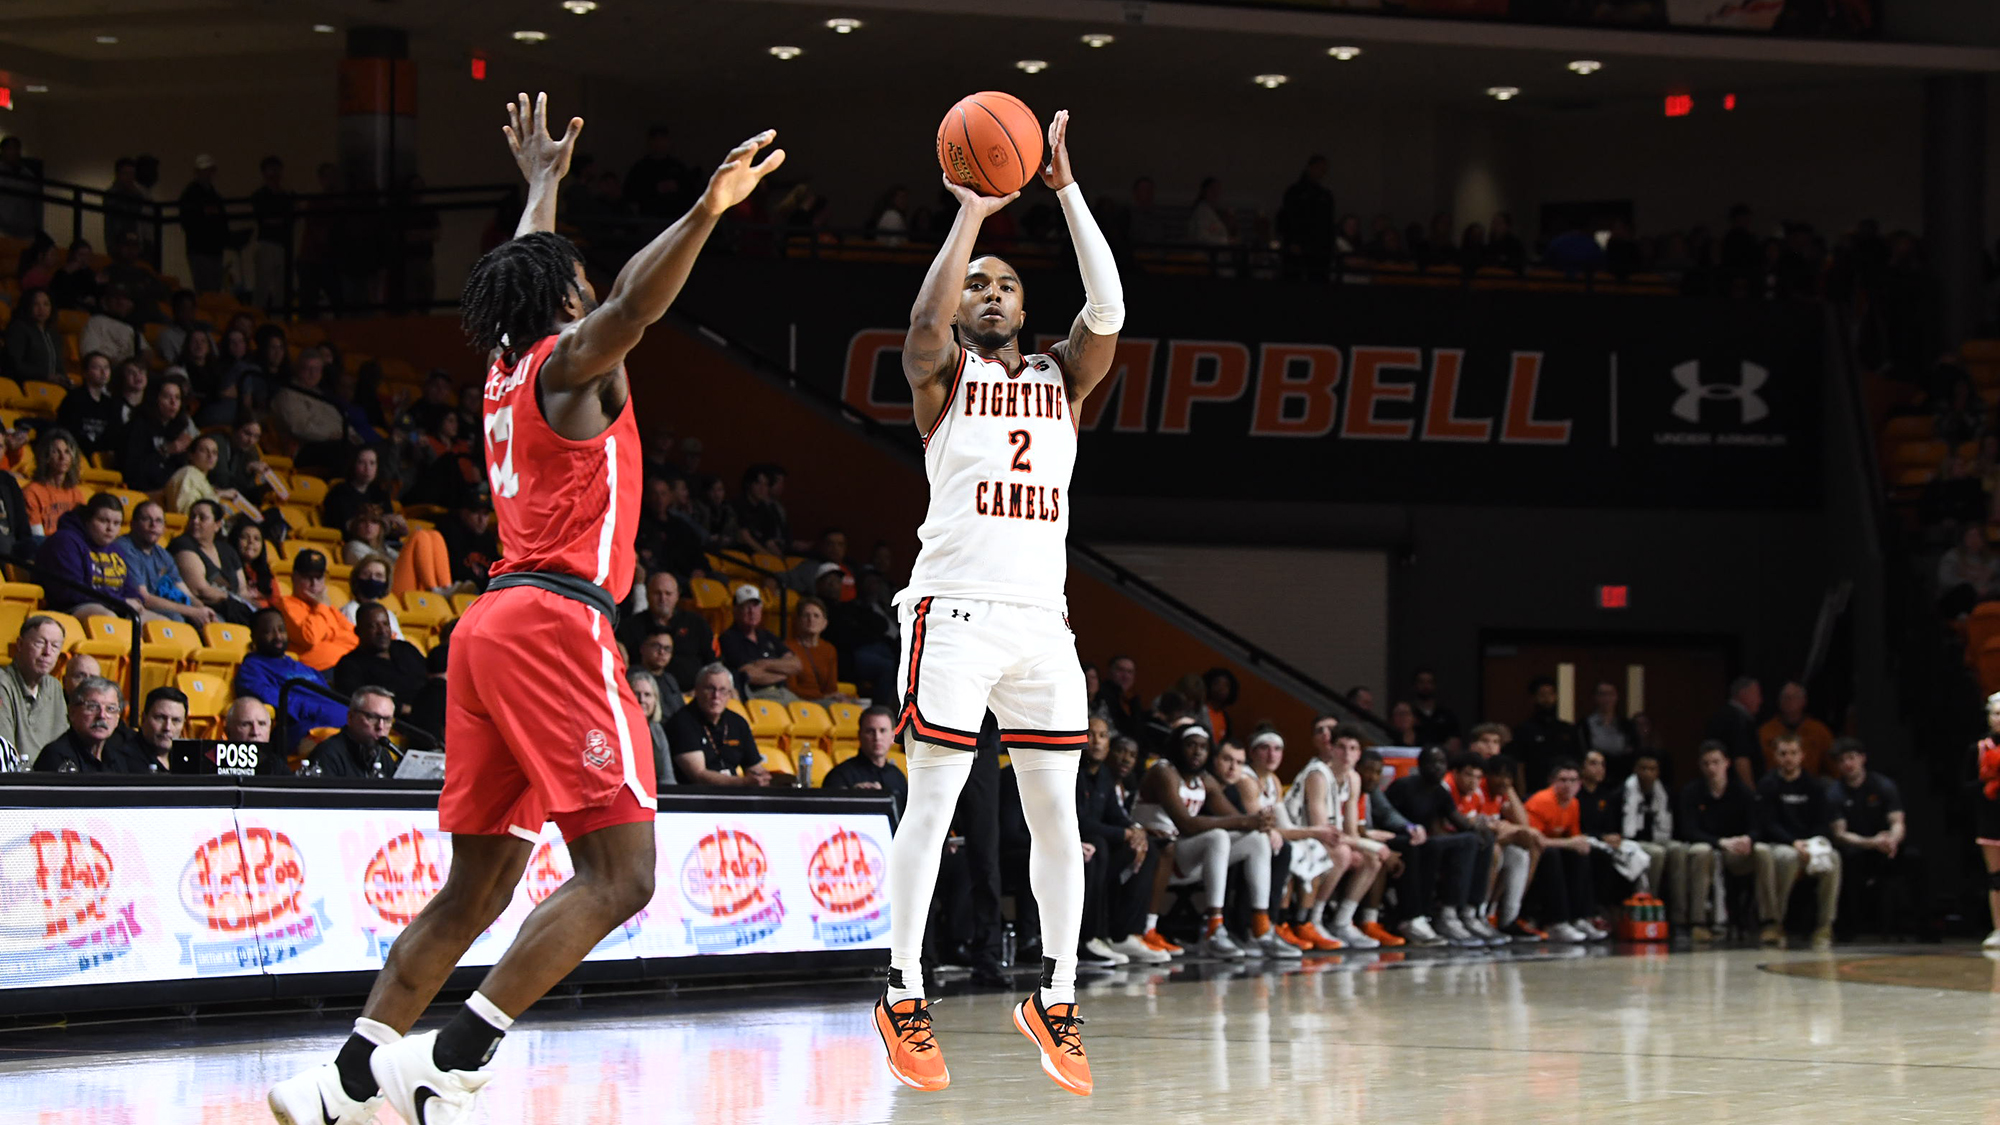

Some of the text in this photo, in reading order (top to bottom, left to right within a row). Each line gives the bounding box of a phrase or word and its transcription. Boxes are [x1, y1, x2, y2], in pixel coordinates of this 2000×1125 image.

[842, 329, 1573, 445] CMPBELL
[964, 381, 1062, 420] FIGHTING
[1008, 429, 1032, 473] 2
[976, 481, 1060, 522] CAMELS
[216, 743, 259, 768] POSS
[217, 767, 256, 776] DAKTRONICS
